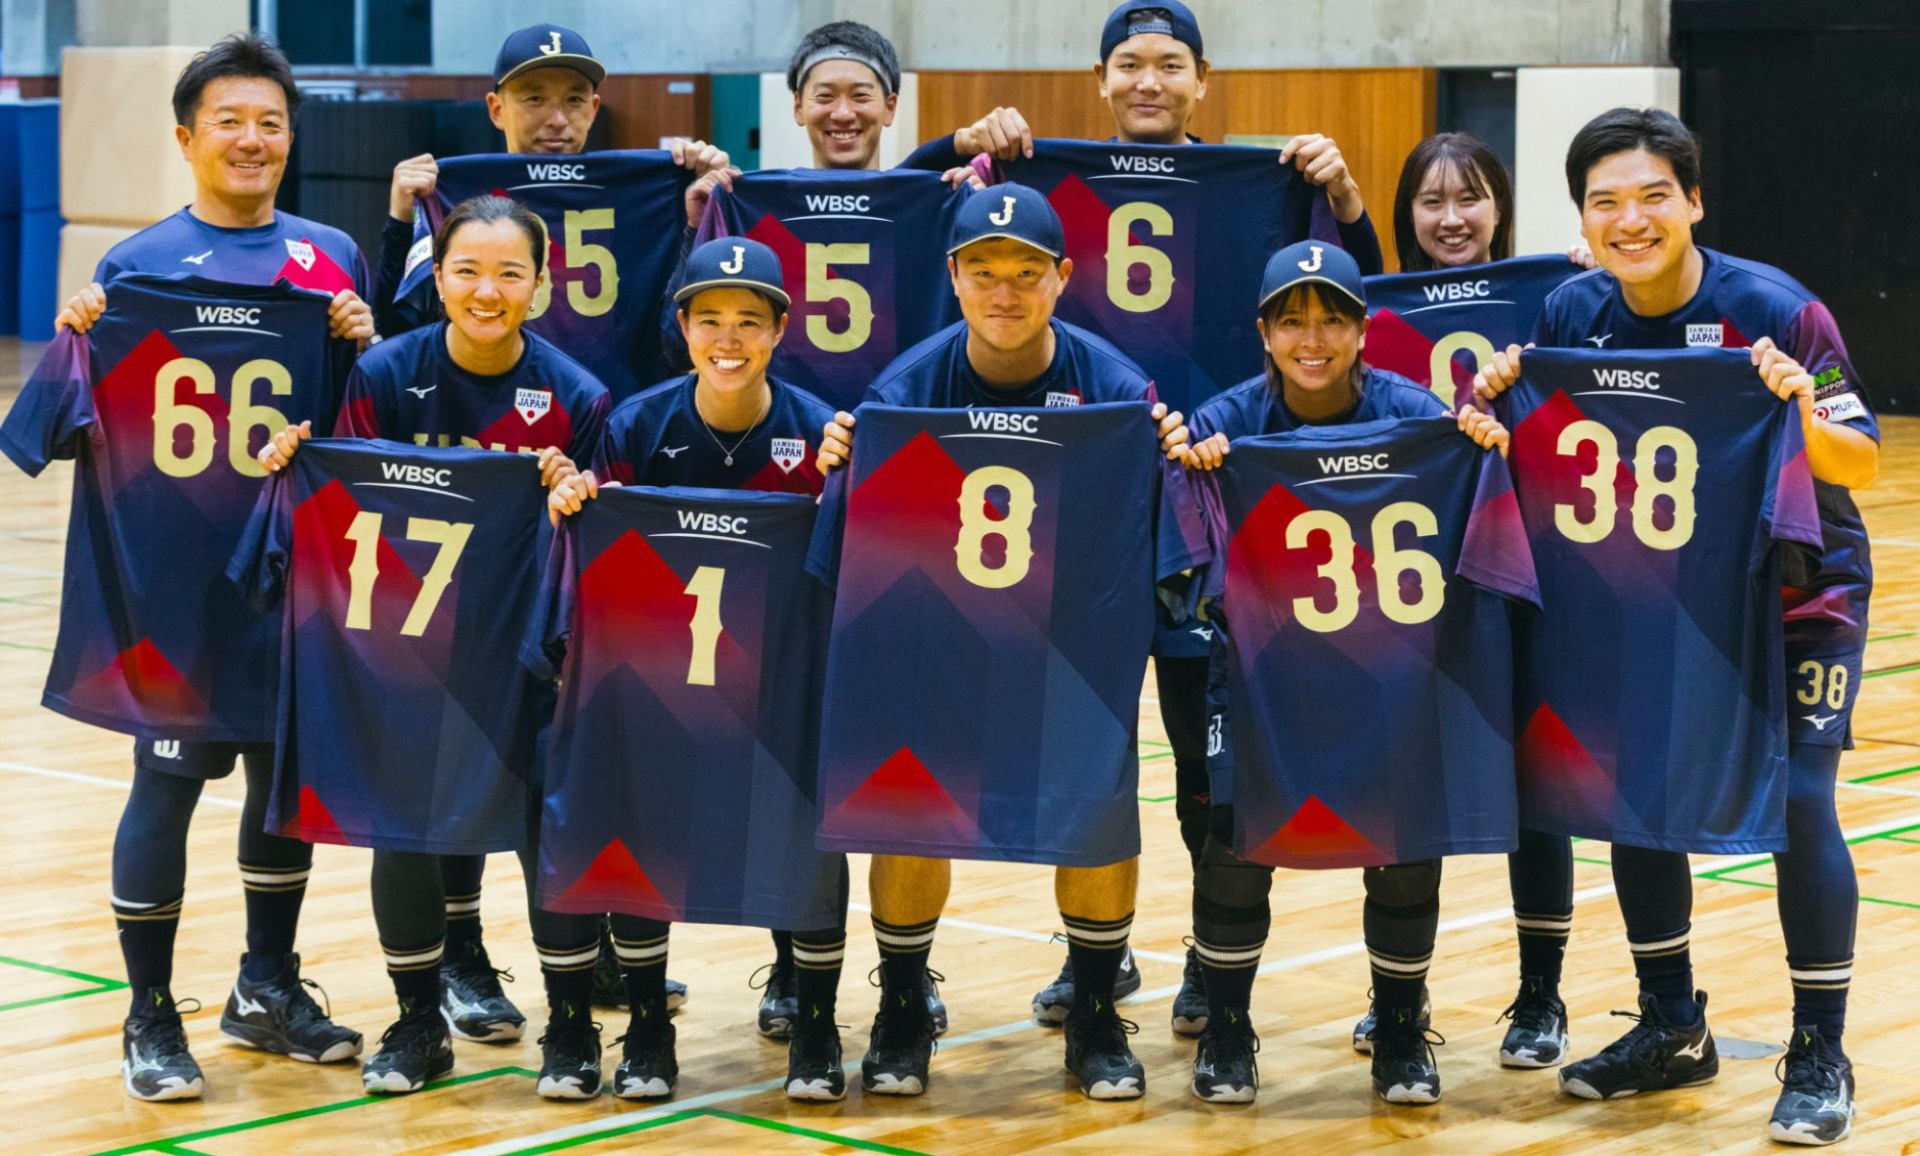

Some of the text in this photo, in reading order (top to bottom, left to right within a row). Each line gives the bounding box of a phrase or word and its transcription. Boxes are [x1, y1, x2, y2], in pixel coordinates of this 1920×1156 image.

[539, 31, 562, 56] J
[527, 164, 586, 181] WBSC
[1111, 155, 1175, 173] WBSC
[805, 195, 870, 213] WBSC
[989, 195, 1016, 227] J
[720, 245, 745, 275] J
[1104, 201, 1176, 313] 6
[1298, 246, 1324, 273] J
[805, 243, 874, 353] 5
[1423, 280, 1491, 302] WBSC
[196, 306, 262, 329] WBSC
[1688, 333, 1721, 343] JAPAN
[1592, 368, 1660, 390] WBSC
[1814, 378, 1847, 395] NIPPON
[517, 398, 548, 410] JAPAN
[1830, 400, 1861, 415] MUFG
[151, 357, 293, 478] 66
[967, 410, 1039, 434] WBSC
[772, 447, 803, 459] JAPAN
[1317, 453, 1389, 474] WBSC
[381, 462, 451, 486] WBSC
[1554, 420, 1699, 551] 38
[677, 510, 749, 535] WBSC
[954, 465, 1037, 589] 8
[345, 511, 474, 637] 17
[1285, 501, 1447, 633] 36
[683, 566, 726, 686] 1
[1797, 660, 1848, 710] 38
